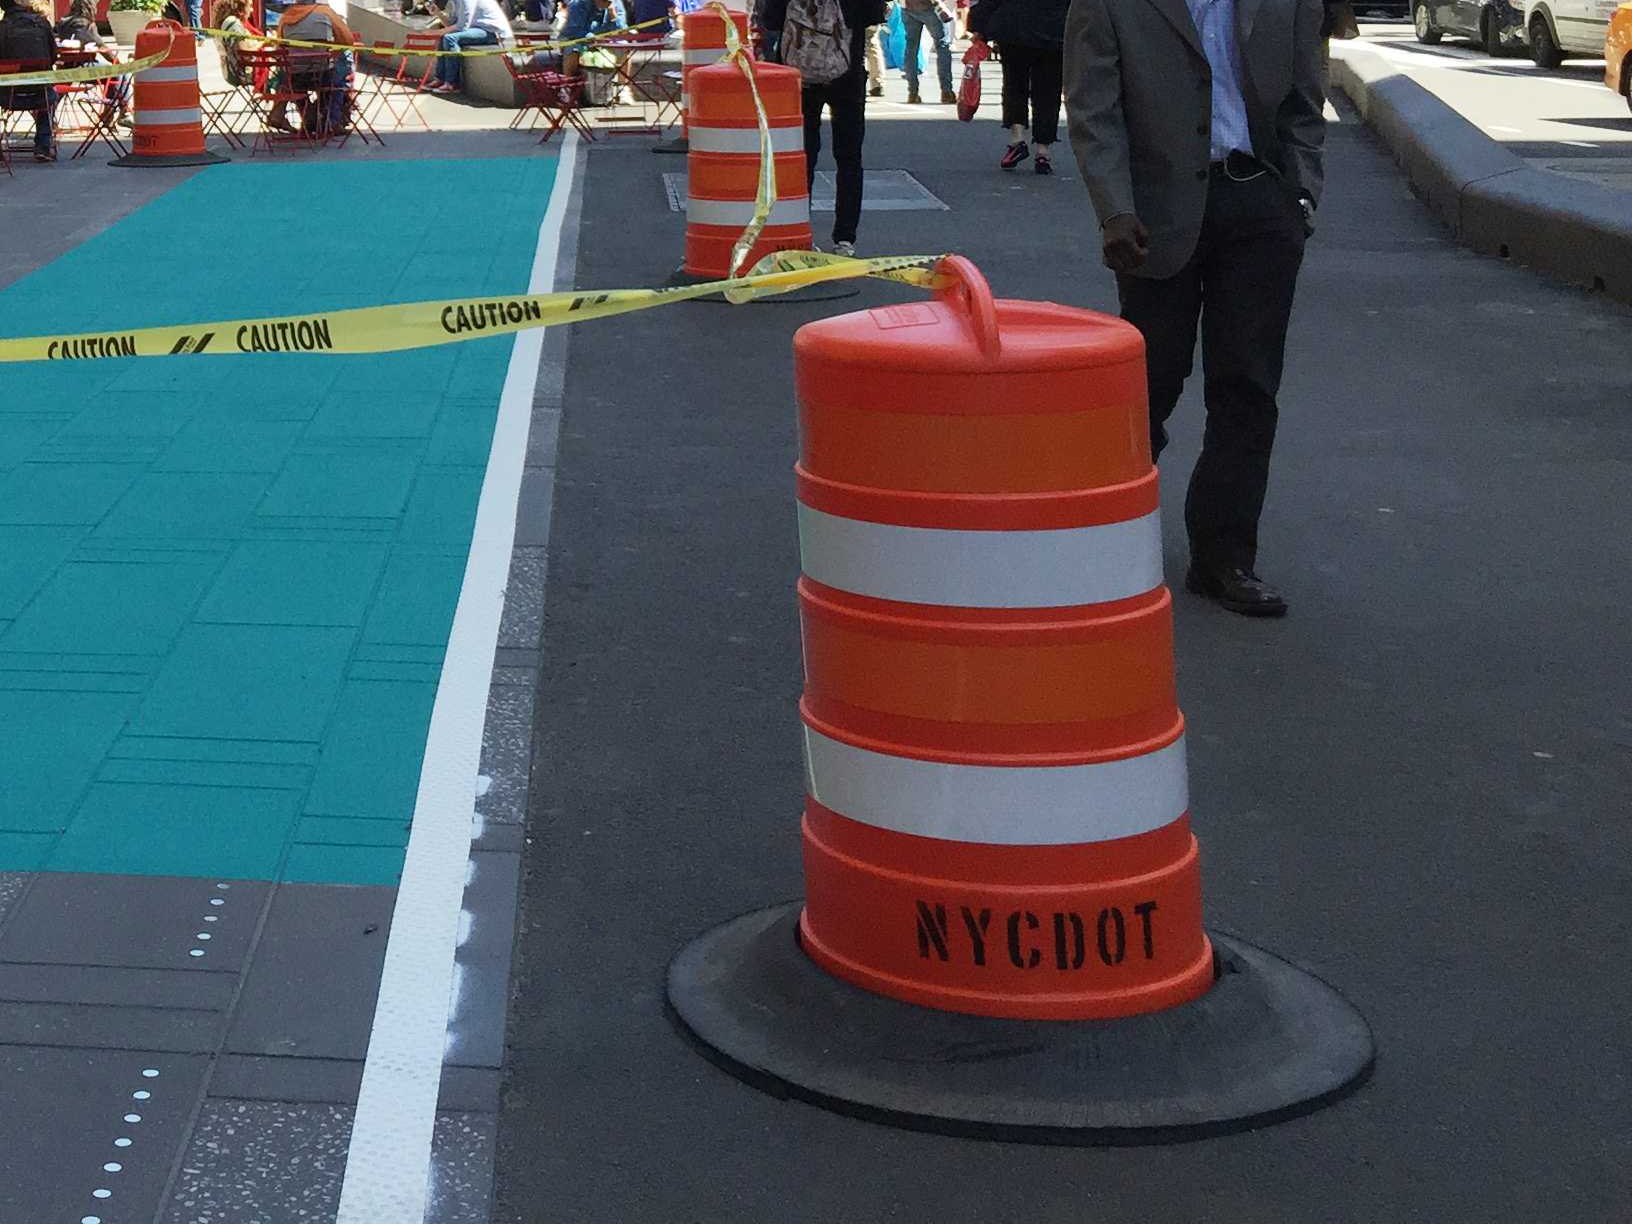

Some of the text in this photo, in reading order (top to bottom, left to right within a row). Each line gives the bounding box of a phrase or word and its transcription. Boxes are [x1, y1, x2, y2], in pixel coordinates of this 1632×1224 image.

[48, 335, 135, 359] CAUTION
[236, 318, 333, 353] CAUTION
[441, 300, 541, 334] CAUTION
[916, 899, 1158, 971] NYCDOT
